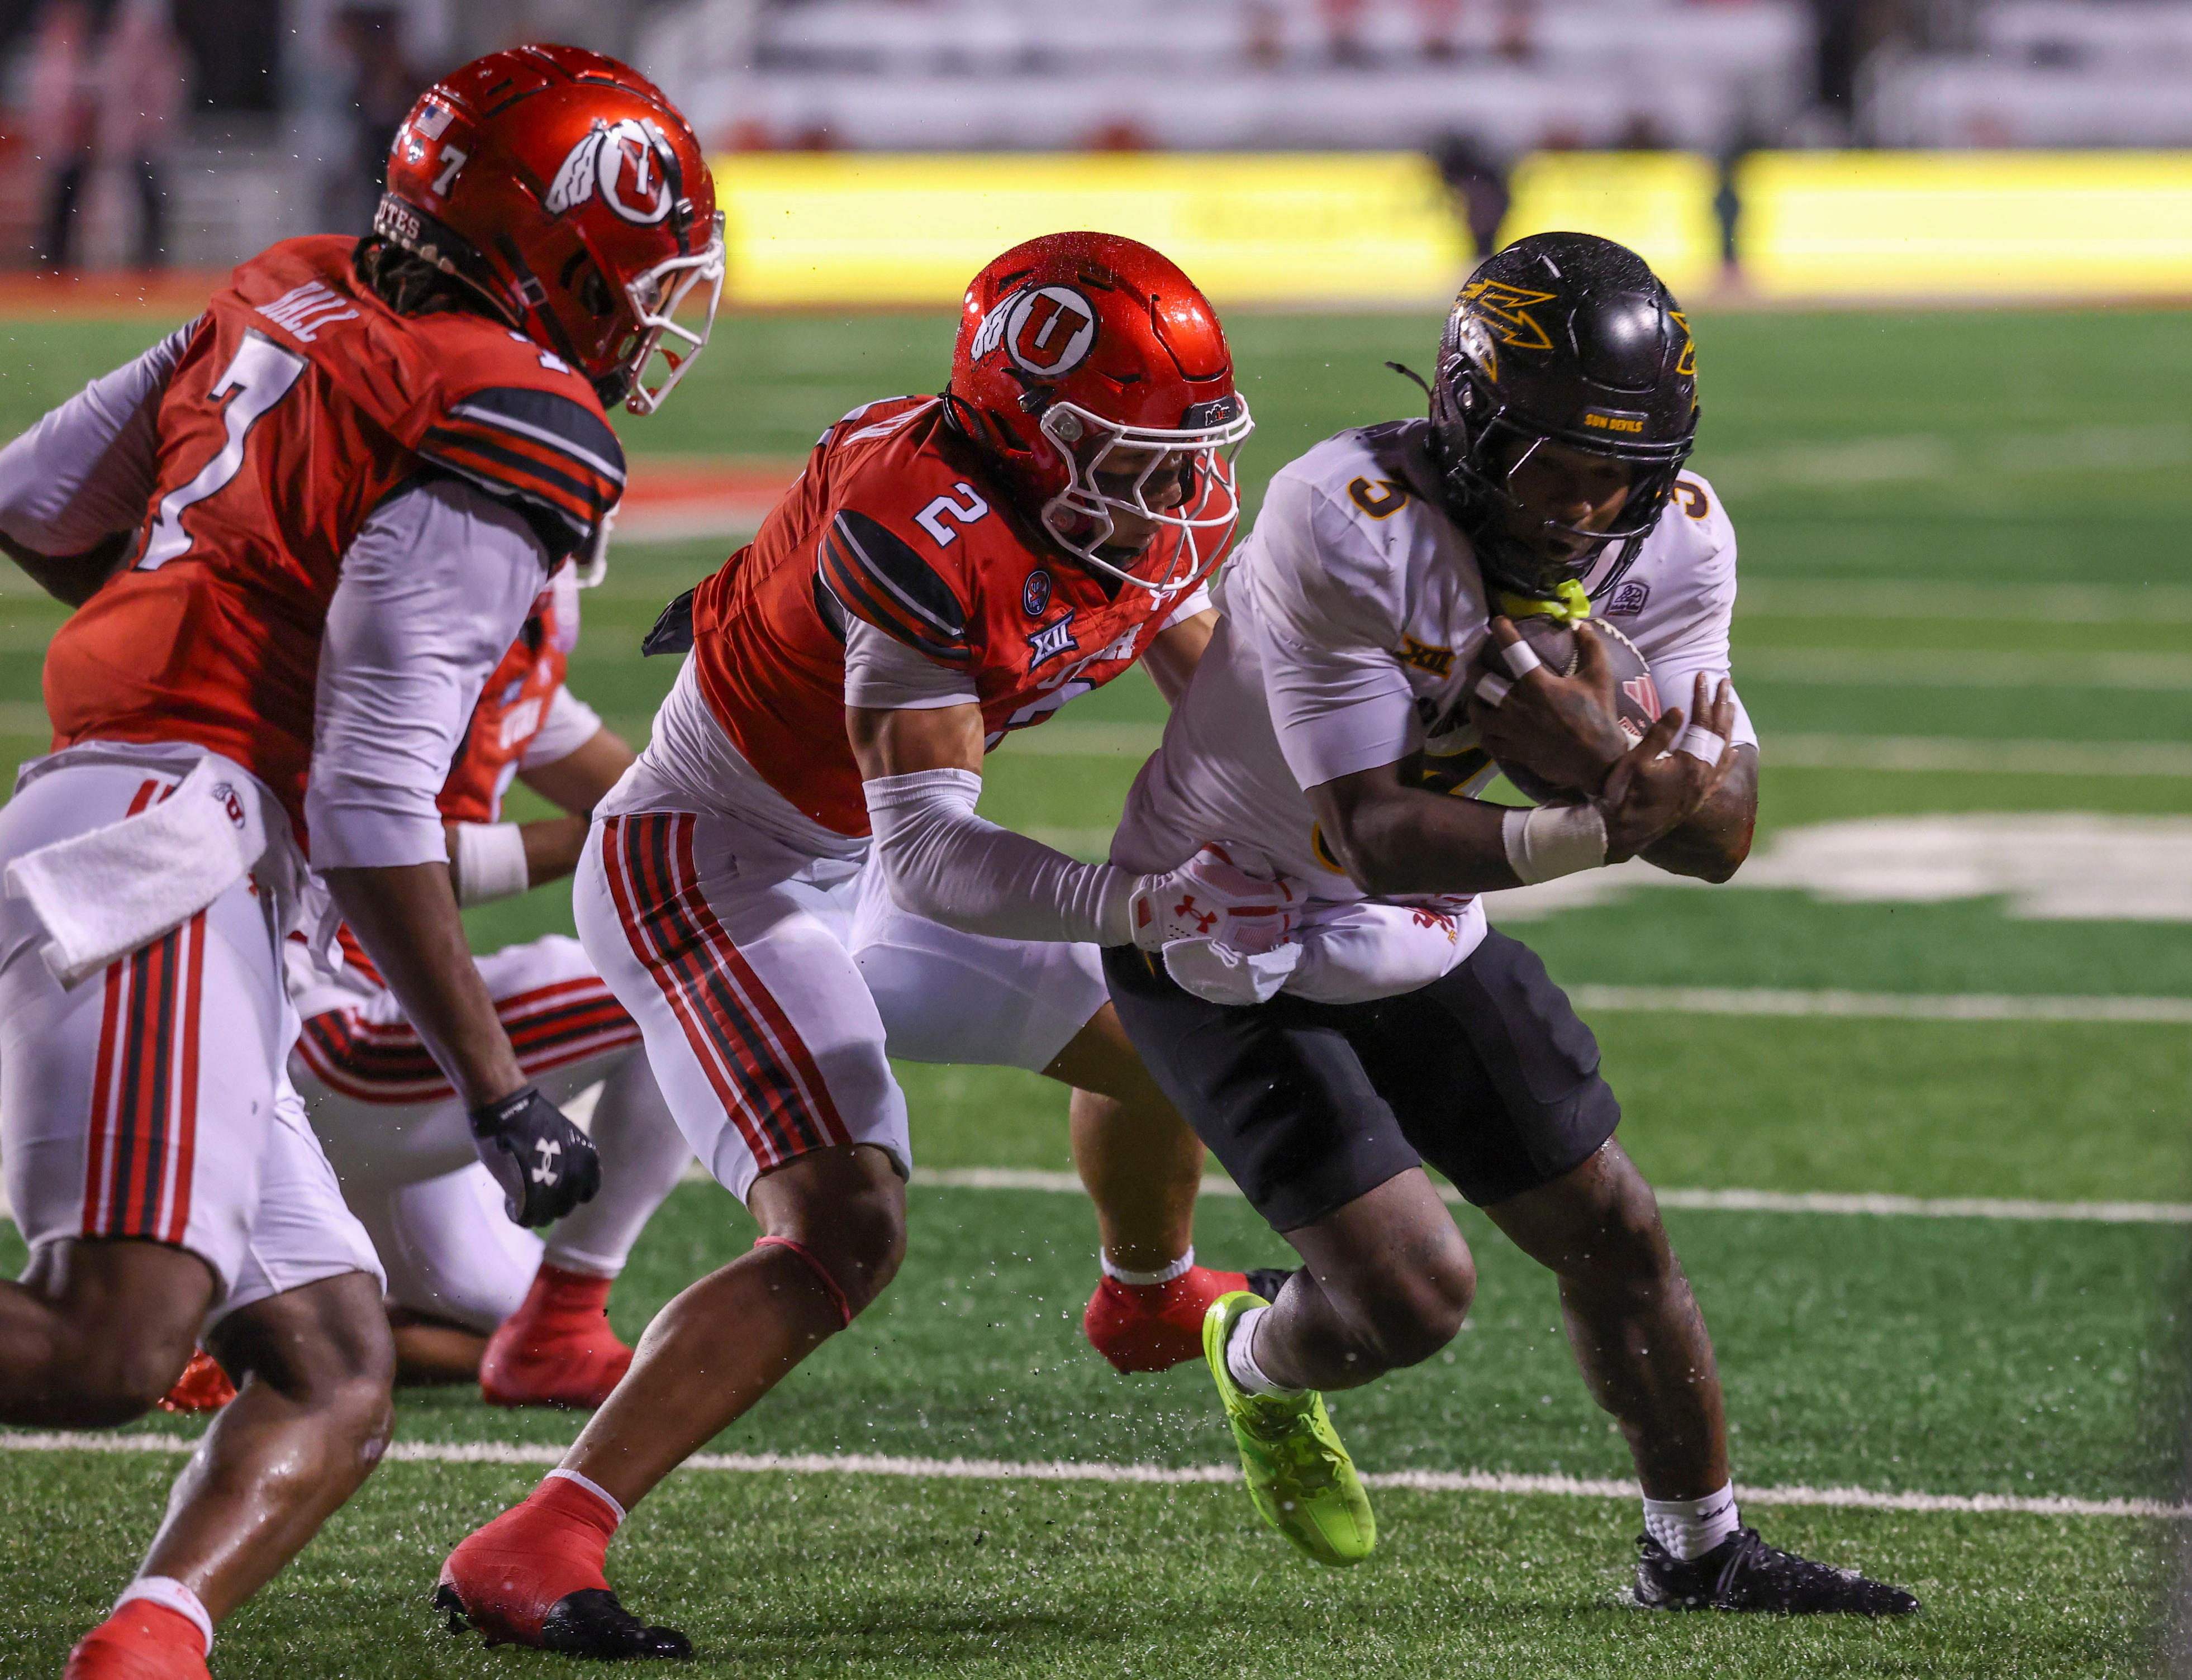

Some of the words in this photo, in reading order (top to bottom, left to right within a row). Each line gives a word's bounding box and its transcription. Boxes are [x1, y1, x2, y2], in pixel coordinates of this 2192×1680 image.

[431, 143, 468, 196] 7
[377, 198, 421, 240] UTES
[1015, 292, 1090, 370] U
[131, 326, 311, 573] 7
[1584, 413, 1609, 429] SUN
[1608, 418, 1644, 433] DEVILS
[911, 480, 990, 550] 2
[1028, 612, 1078, 672] XII
